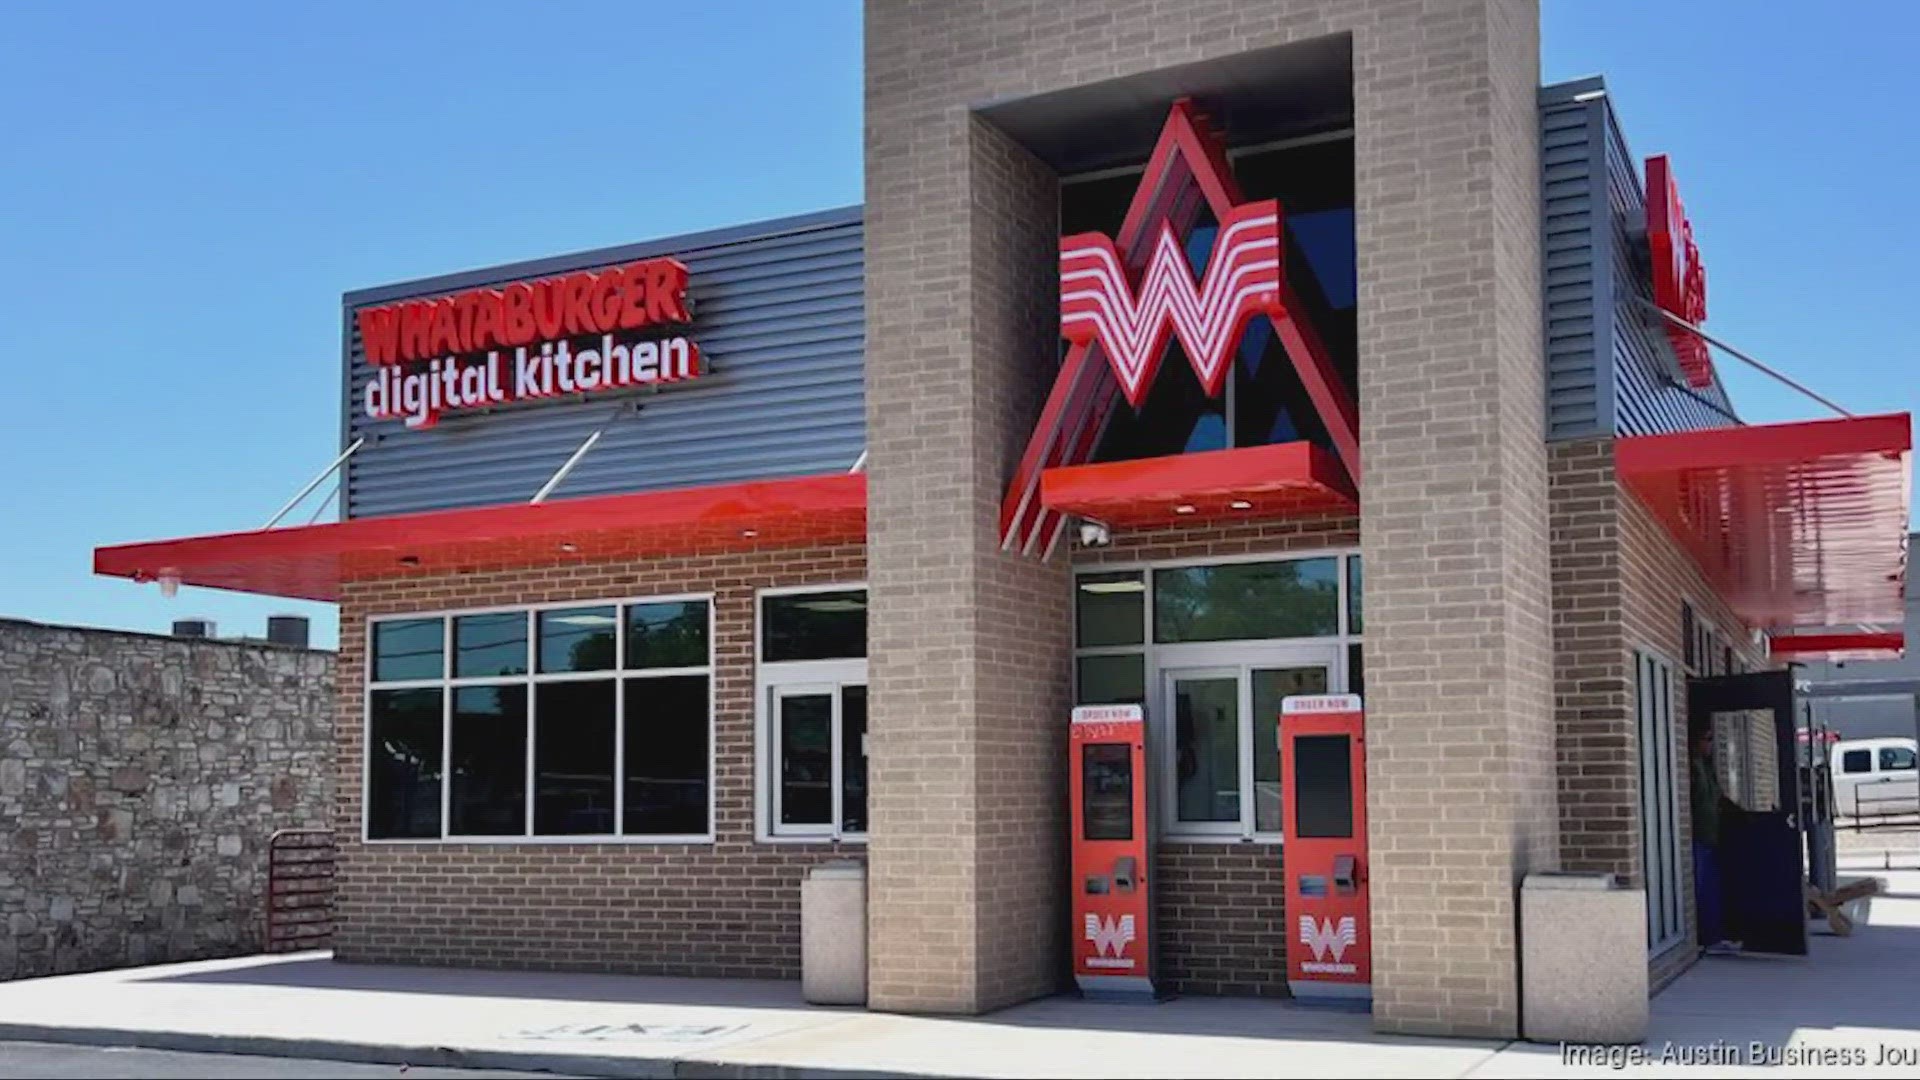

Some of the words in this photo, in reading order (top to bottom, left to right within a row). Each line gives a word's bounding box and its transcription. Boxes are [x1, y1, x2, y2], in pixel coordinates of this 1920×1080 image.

[358, 257, 690, 365] WHATABURGER
[364, 351, 504, 428] digital
[514, 335, 692, 397] kitchen
